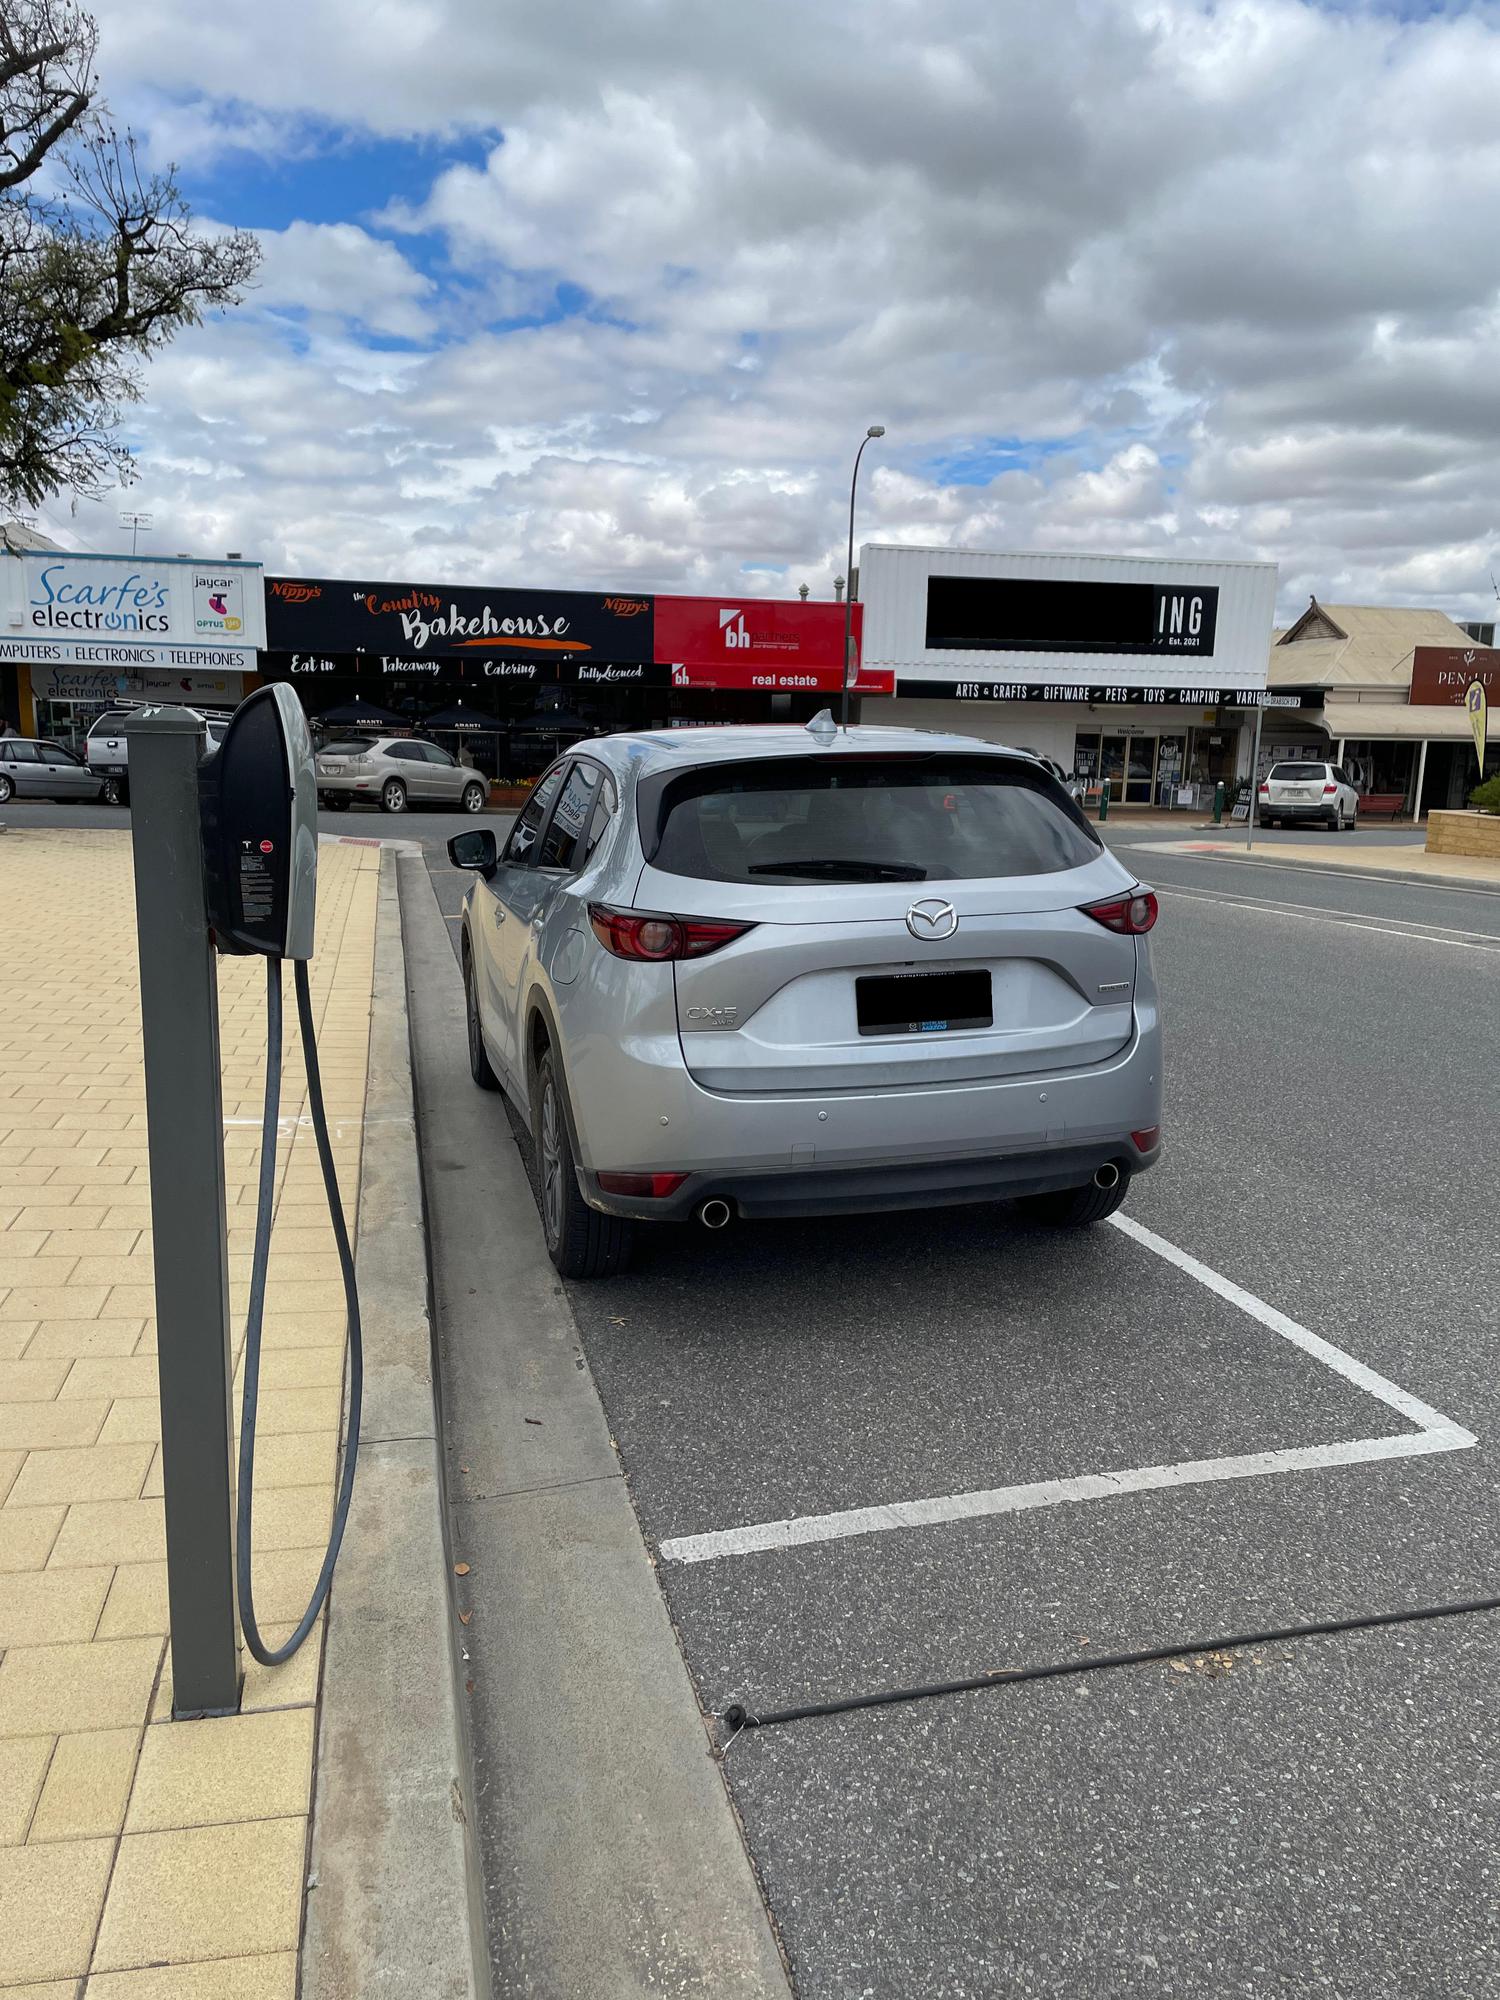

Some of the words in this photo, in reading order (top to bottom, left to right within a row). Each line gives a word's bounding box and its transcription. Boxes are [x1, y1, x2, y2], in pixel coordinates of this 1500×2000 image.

[30, 565, 169, 610] Scarfe's
[195, 576, 233, 588] jaycar
[269, 582, 322, 602] Nippy's
[353, 592, 366, 601] the
[365, 590, 442, 615] Country
[601, 597, 650, 617] Nippy's
[32, 604, 169, 632] electronics
[196, 619, 224, 628] OPTUS
[399, 604, 570, 649] Bakehouse
[725, 614, 750, 648] bh
[1183, 637, 1200, 647] 2021
[75, 646, 155, 663] ELECTRONICS
[169, 650, 245, 666] TELEPHONES
[290, 654, 318, 673] Eat
[320, 656, 336, 671] in
[379, 656, 441, 676] Takeaway
[483, 660, 538, 678] Catering
[675, 666, 690, 685] bh
[752, 674, 776, 685] real
[779, 674, 818, 686] estate
[48, 686, 120, 699] electronics
[956, 683, 980, 698] ARTS
[983, 687, 989, 695] &
[993, 684, 1028, 699] CRAFTS
[1043, 686, 1090, 700] GIFTWARE
[1105, 687, 1128, 702] PETS
[1143, 688, 1166, 703] TOYS
[1179, 689, 1221, 704] CAMPING
[686, 1006, 738, 1019] CX-5
